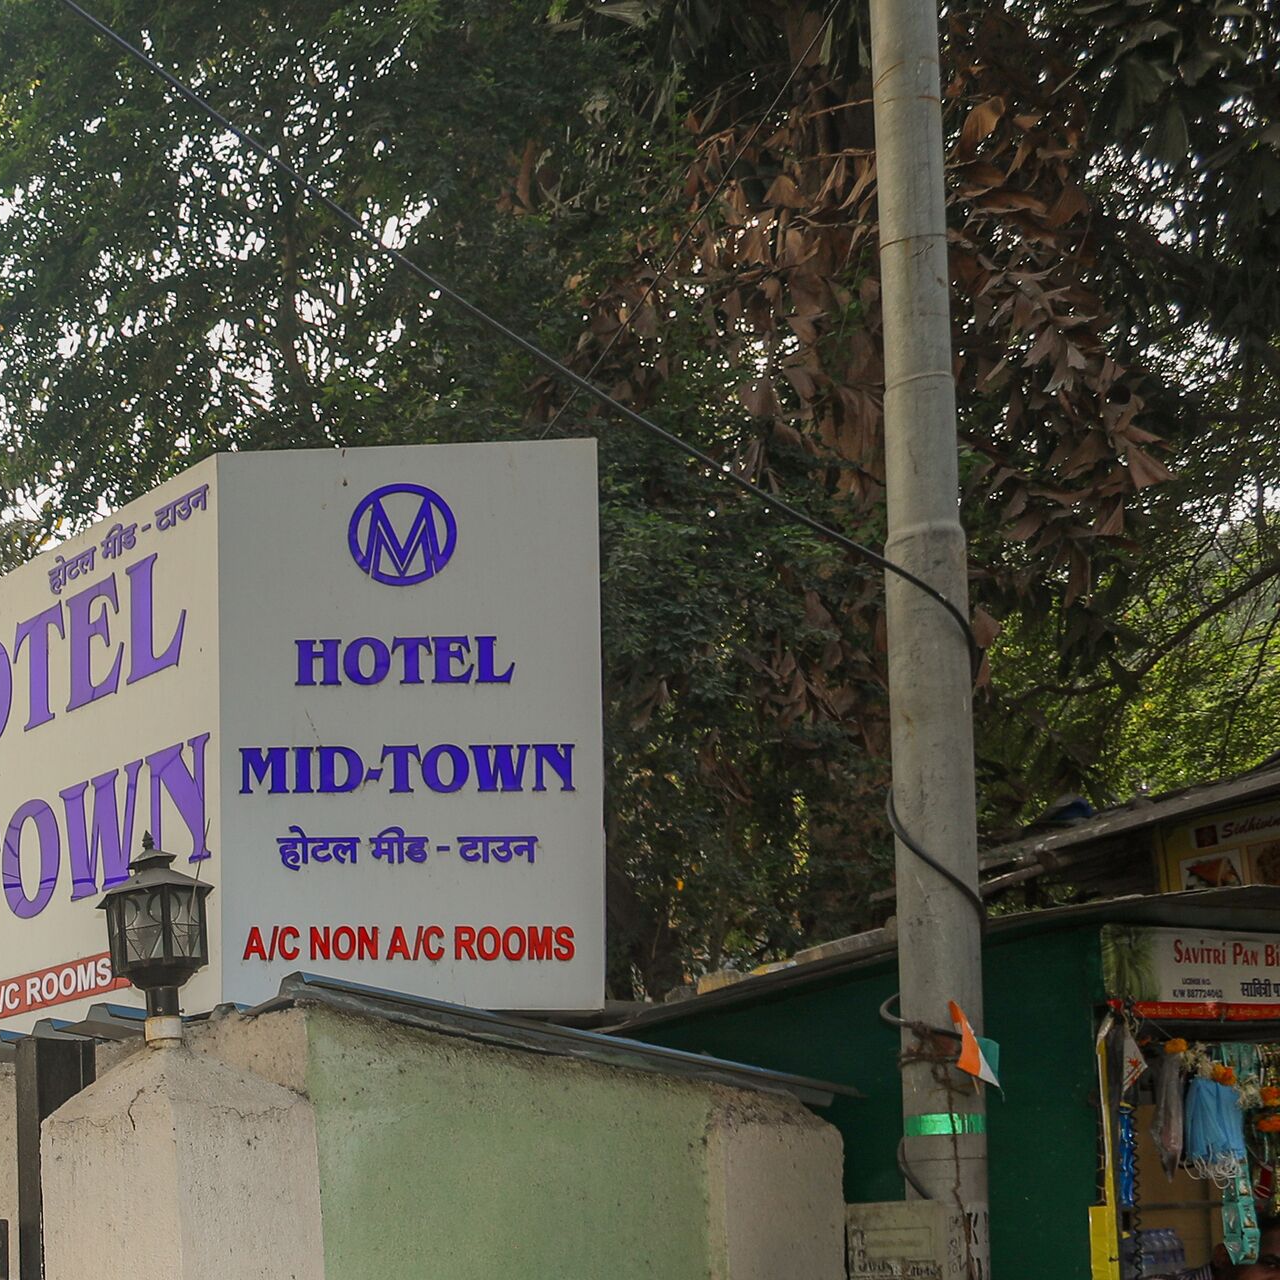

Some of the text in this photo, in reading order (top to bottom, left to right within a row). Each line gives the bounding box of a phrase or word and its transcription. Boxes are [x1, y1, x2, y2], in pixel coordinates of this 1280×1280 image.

[48, 547, 97, 595] होटल
[100, 523, 138, 560] मीड
[154, 483, 209, 531] टाउन
[294, 635, 516, 686] HOTEL
[239, 744, 576, 794] MID-TOWN
[276, 825, 360, 871] होटल
[369, 826, 429, 864] मीड
[456, 835, 539, 864] टाउन
[242, 925, 576, 961] A/C NON A/C ROOMS
[26, 958, 113, 1005] ROOMS
